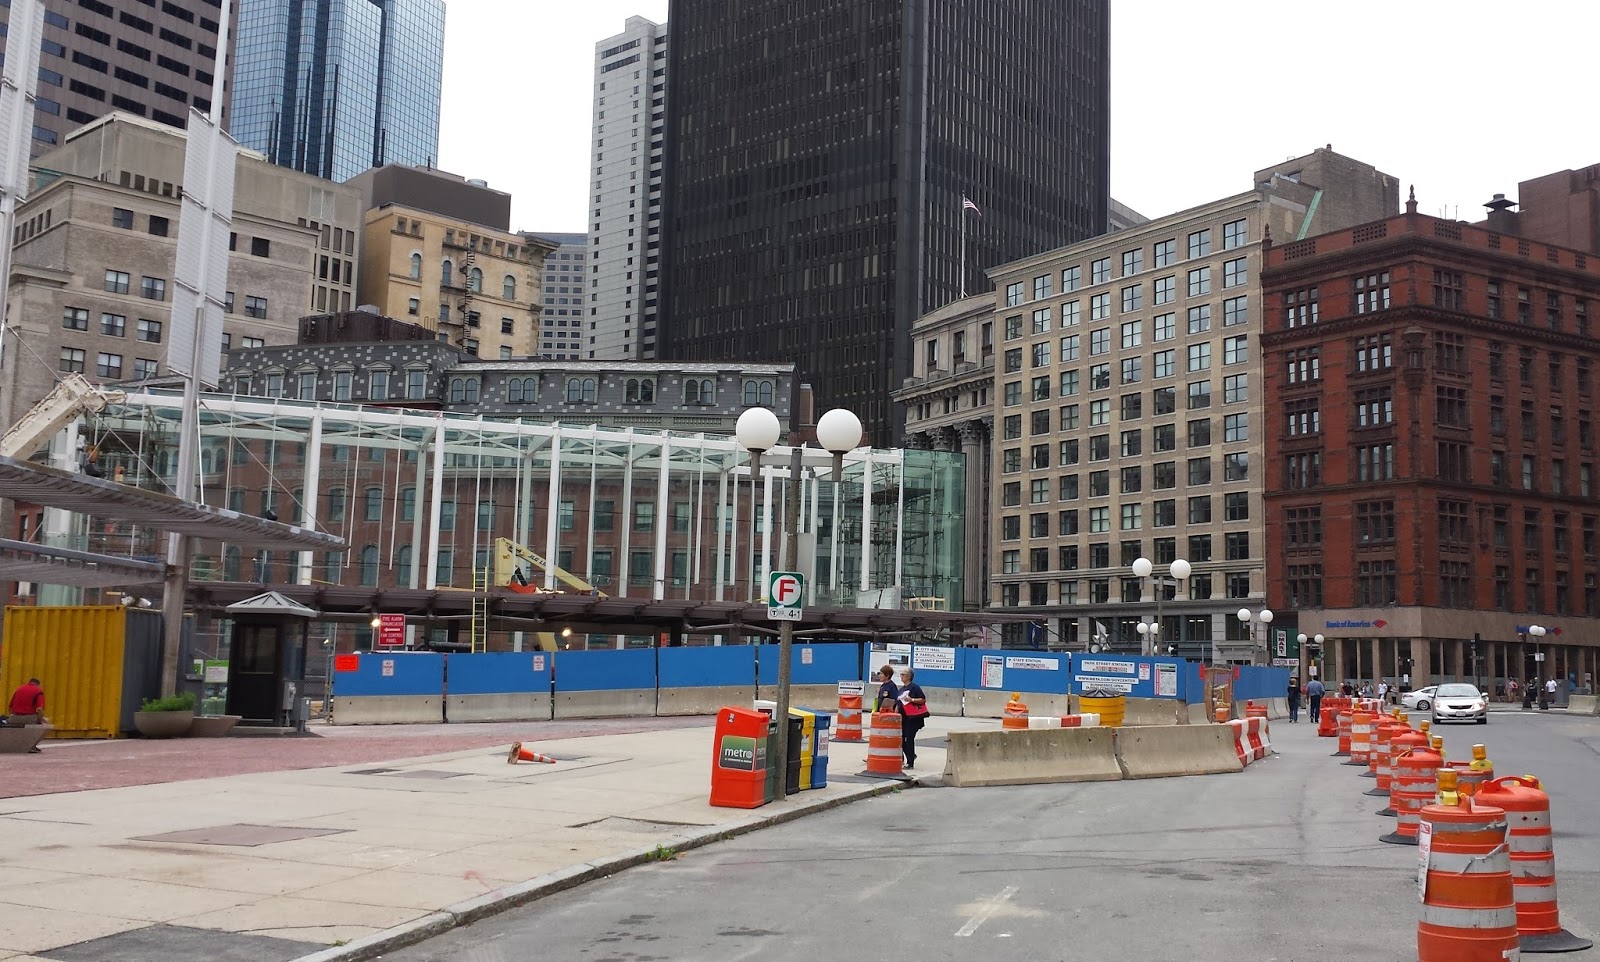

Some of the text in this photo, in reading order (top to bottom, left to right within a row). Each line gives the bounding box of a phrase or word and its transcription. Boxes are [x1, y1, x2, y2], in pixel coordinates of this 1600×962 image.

[779, 579, 796, 602] F
[788, 609, 801, 619] 4-1
[724, 747, 753, 759] metro
